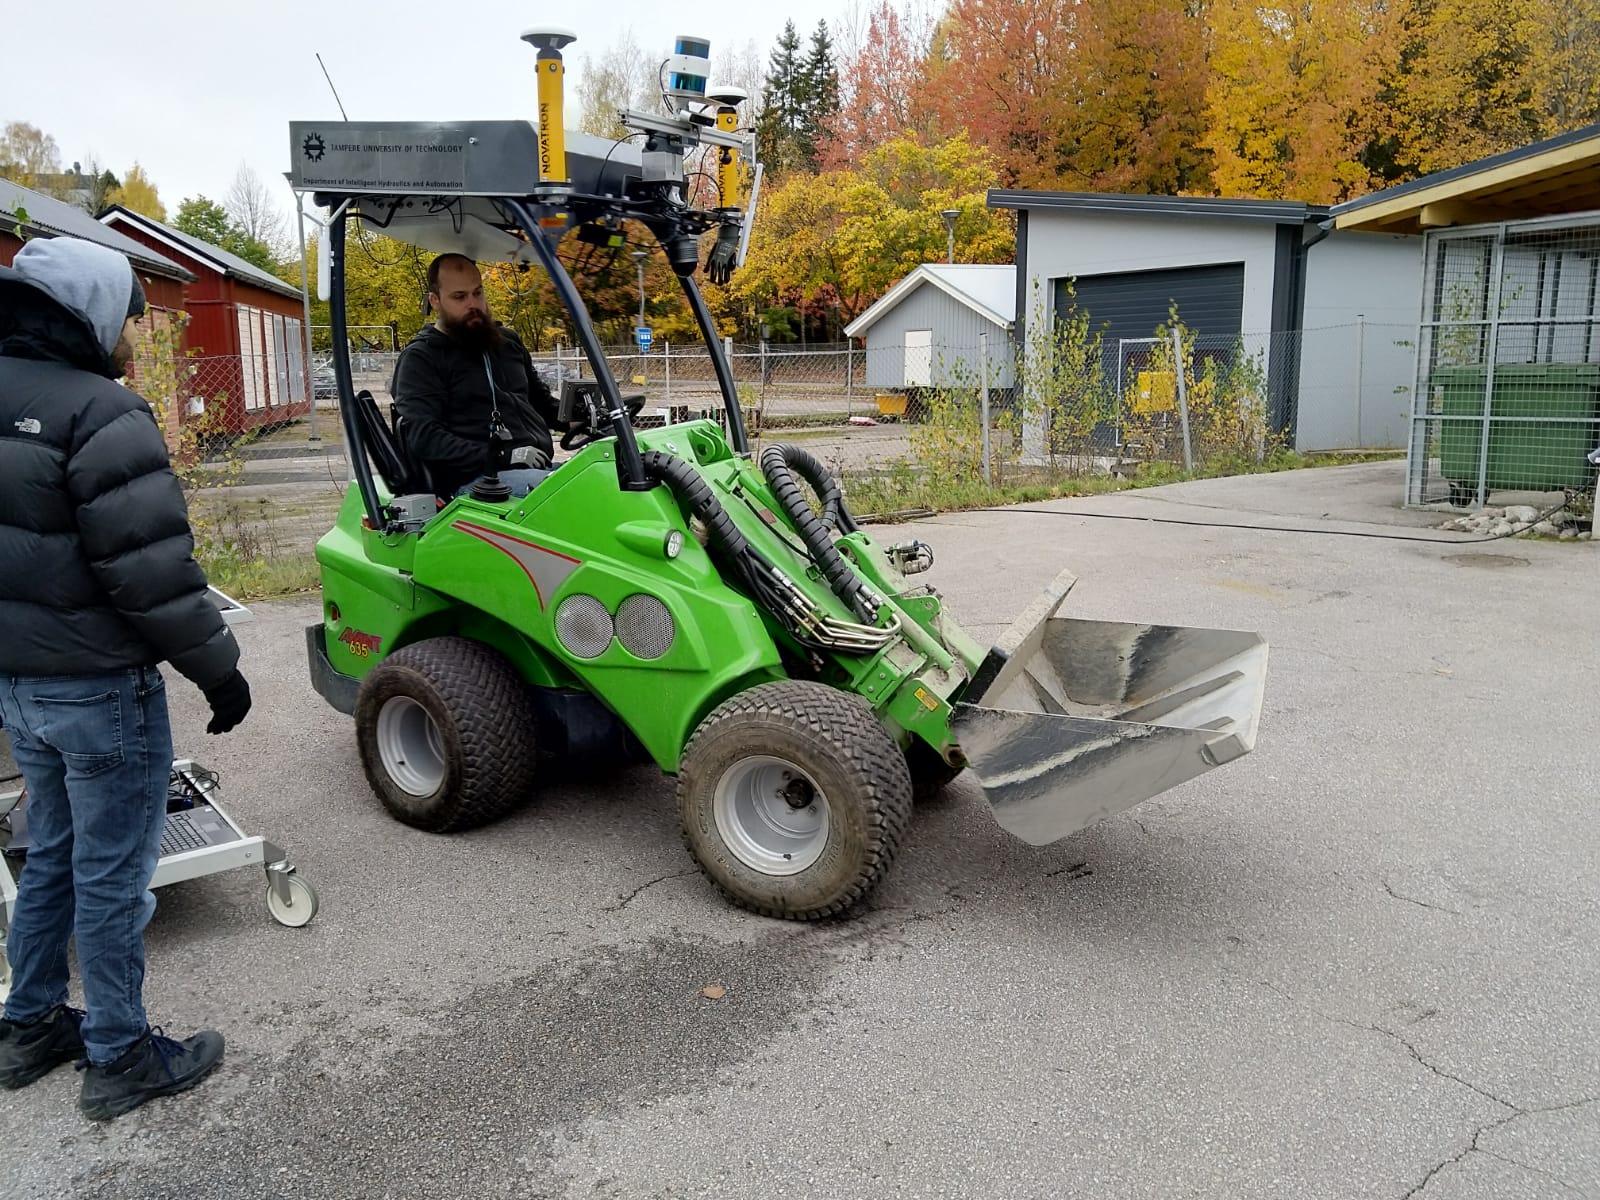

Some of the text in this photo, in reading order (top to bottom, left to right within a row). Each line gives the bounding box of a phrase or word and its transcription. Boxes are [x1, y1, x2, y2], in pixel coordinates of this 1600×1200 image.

[541, 103, 550, 174] NOVATRON
[331, 144, 361, 152] TAMPERE
[363, 145, 402, 153] UNIVERSITY
[404, 145, 413, 153] OF
[303, 177, 337, 185] Department
[346, 179, 376, 187] Intelligent
[378, 180, 411, 188] Hydraulics
[425, 180, 463, 188] Automation
[349, 640, 369, 657] 635
